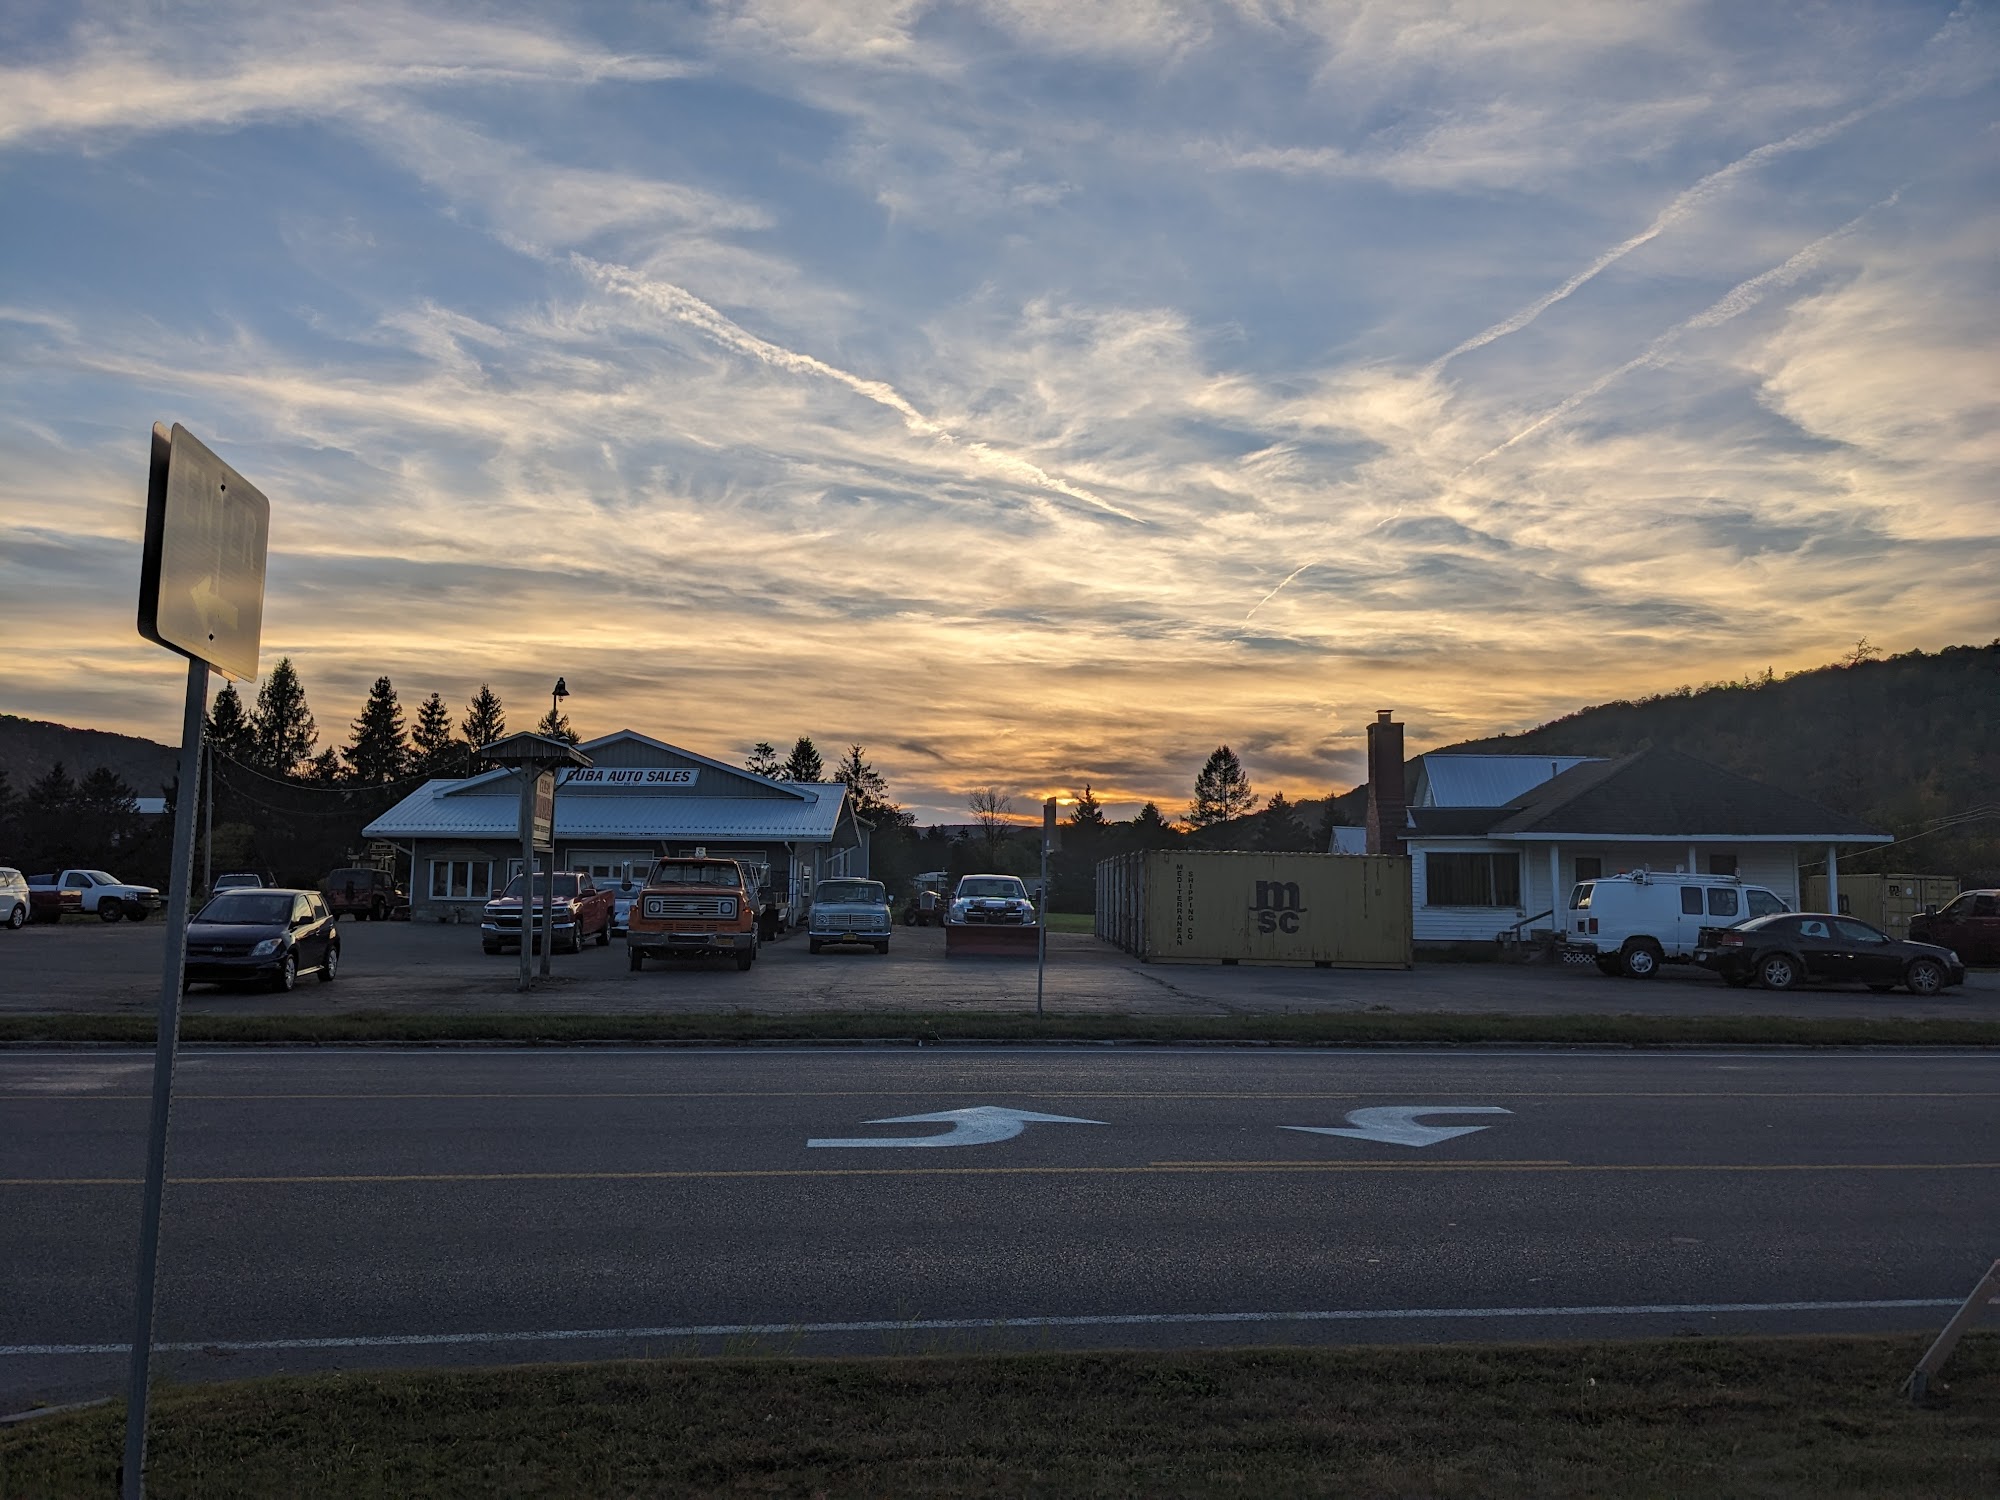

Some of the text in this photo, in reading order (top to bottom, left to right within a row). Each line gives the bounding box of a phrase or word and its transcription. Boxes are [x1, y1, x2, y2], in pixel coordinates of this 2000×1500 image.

[607, 770, 643, 782] AUTO
[646, 771, 691, 783] SALES
[1187, 927, 1193, 940] CO
